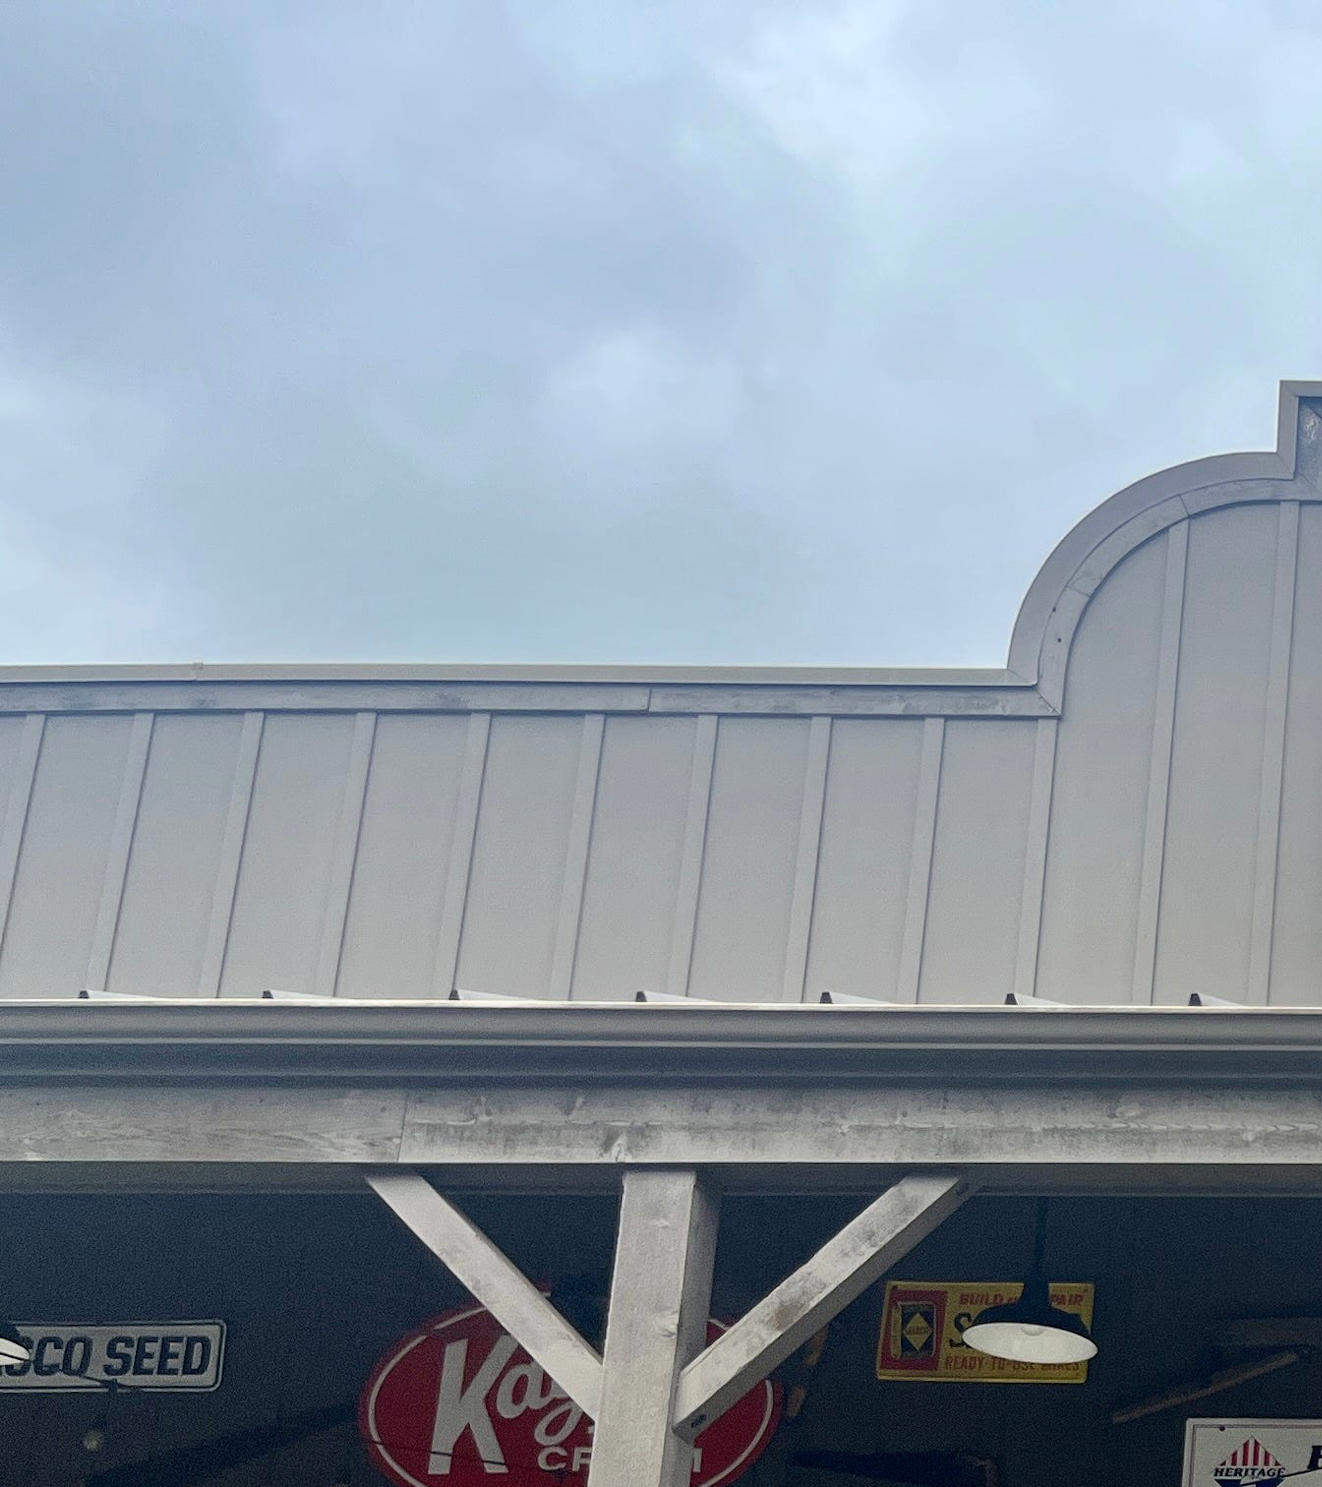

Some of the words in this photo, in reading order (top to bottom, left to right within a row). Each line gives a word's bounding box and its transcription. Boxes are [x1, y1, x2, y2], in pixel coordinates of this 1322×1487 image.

[959, 1293, 1002, 1305] BUILD
[1051, 1293, 1084, 1305] PAIR
[103, 1335, 212, 1376] SEED
[1214, 1466, 1287, 1477] HERITAGE
